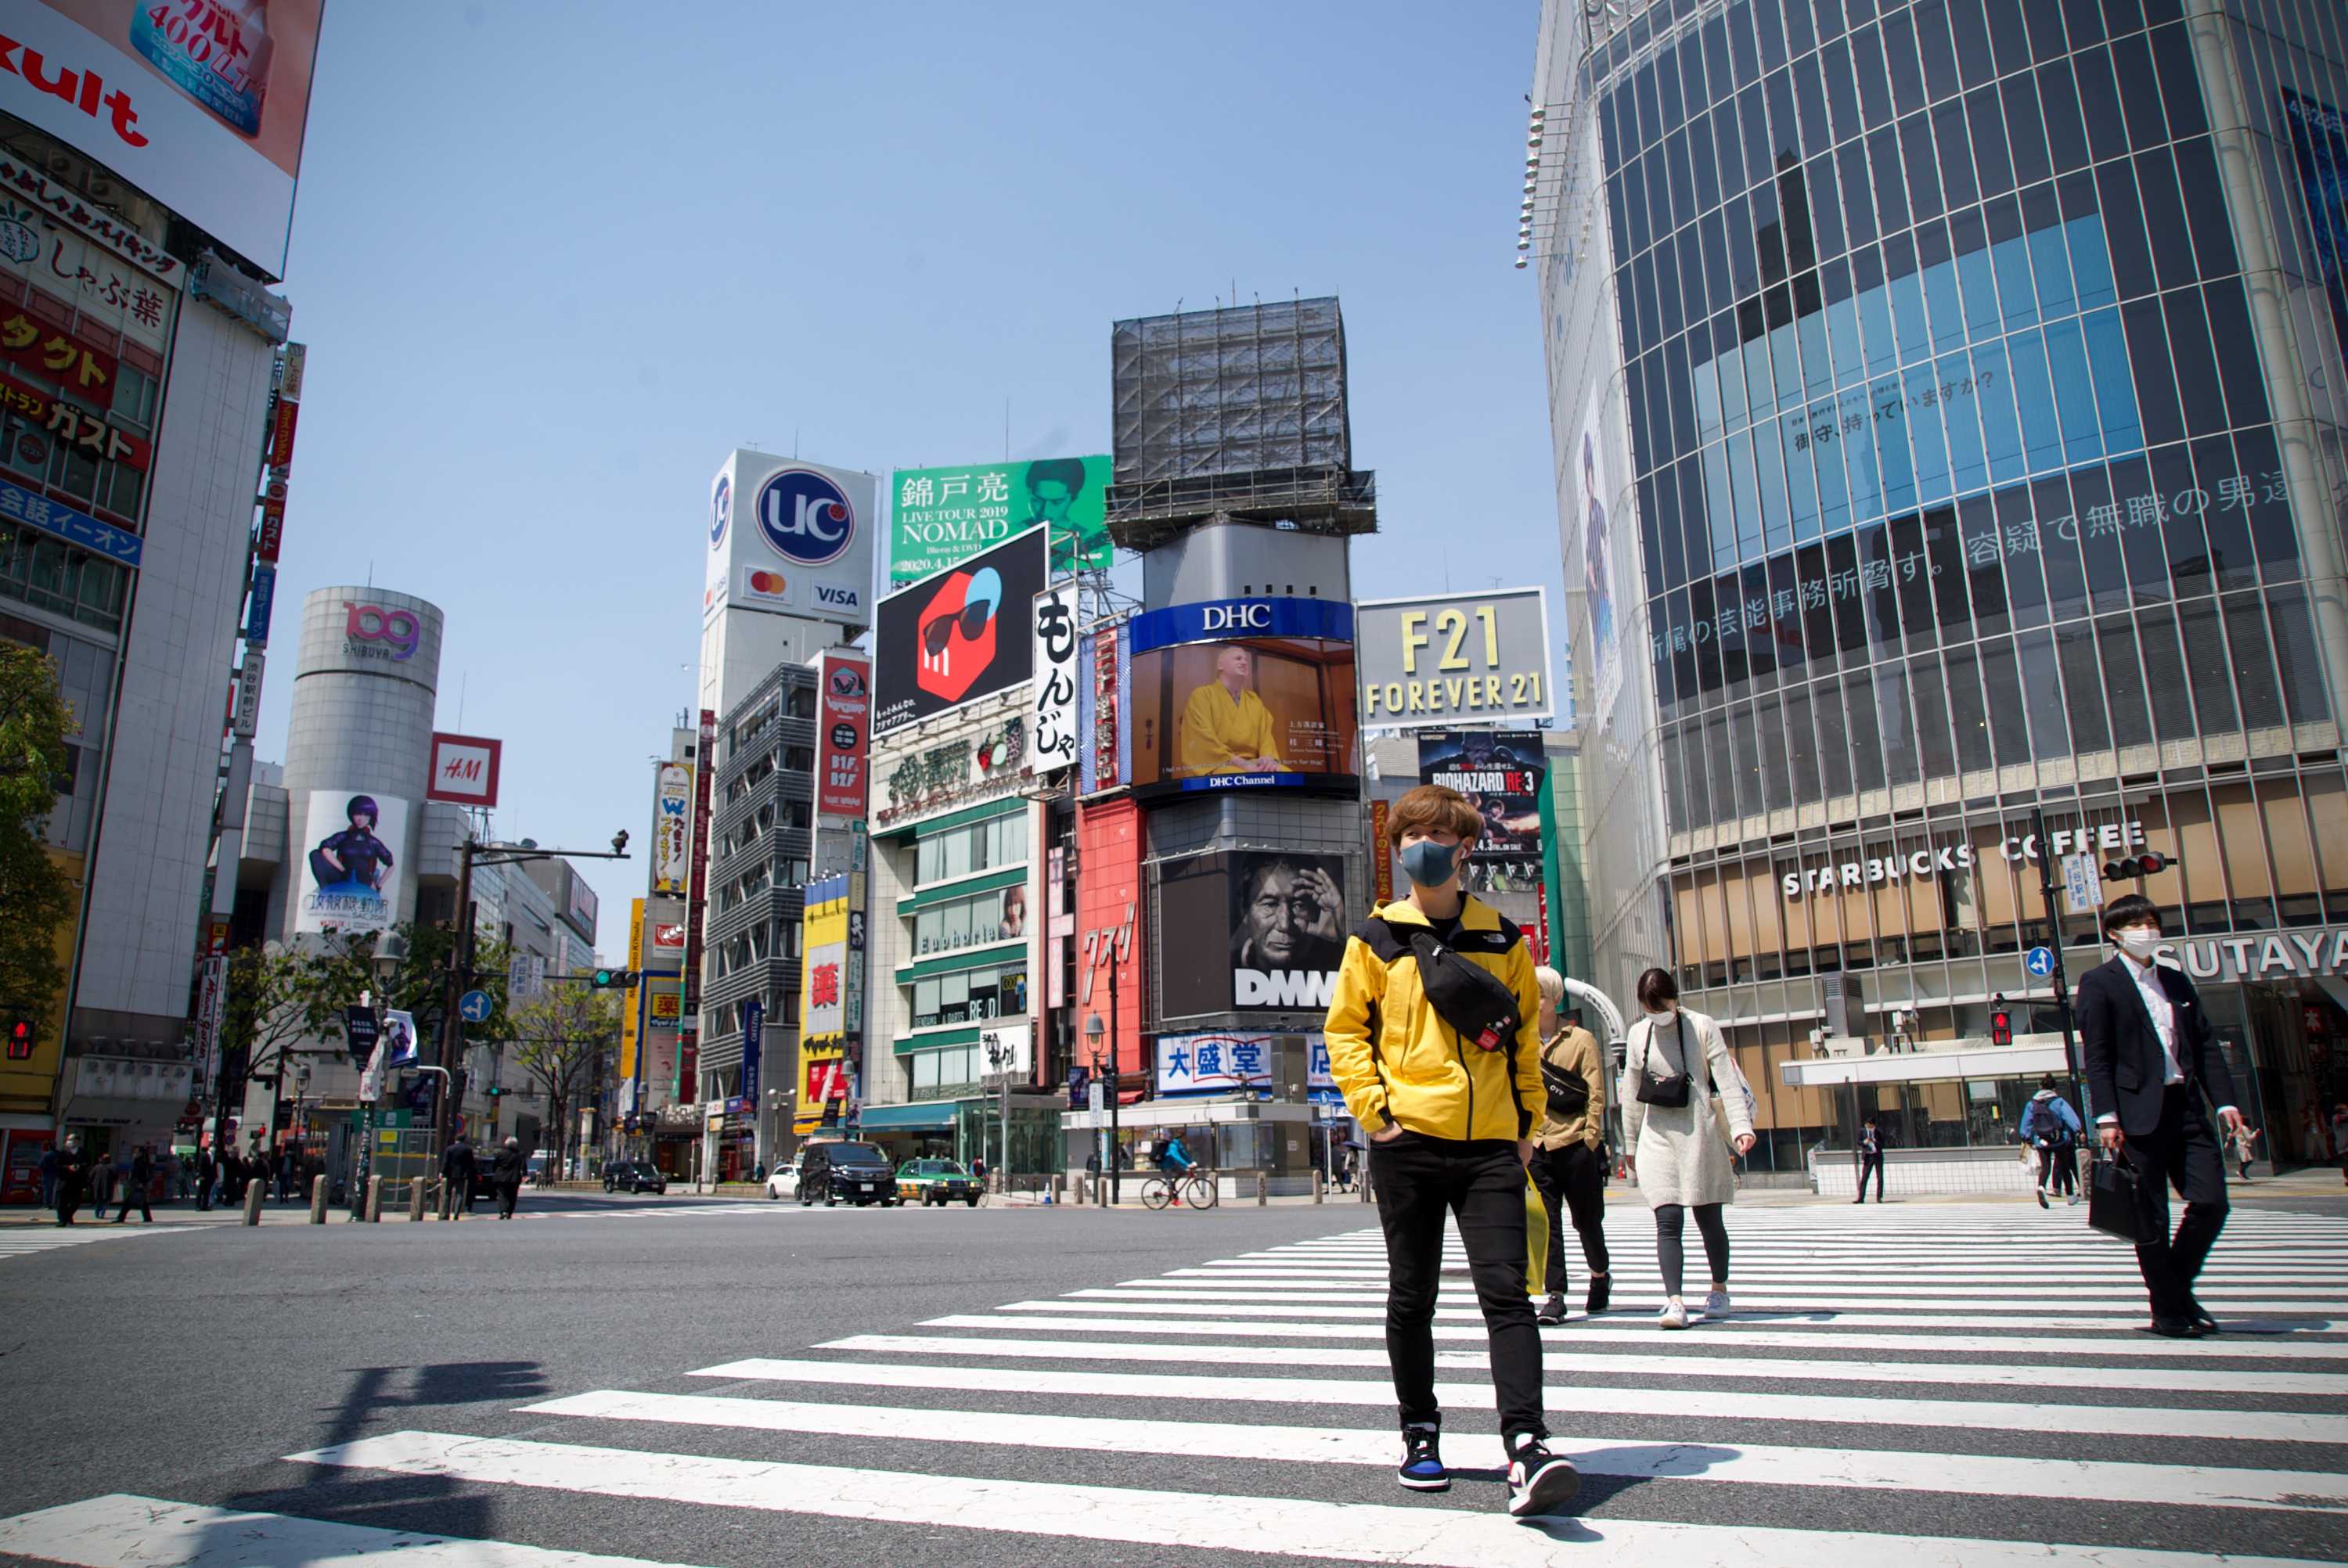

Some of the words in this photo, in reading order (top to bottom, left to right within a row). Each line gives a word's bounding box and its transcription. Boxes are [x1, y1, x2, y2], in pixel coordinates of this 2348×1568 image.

[51, 238, 164, 329] しゃぶ葉
[46, 400, 133, 461] ガスト
[901, 472, 1010, 509] 錦戸亮
[768, 487, 847, 542] UC
[902, 509, 934, 524] LIVE
[938, 508, 976, 522] TOUR
[979, 505, 1009, 520] 2019
[902, 518, 1010, 545] NOMAD
[962, 543, 982, 553] DVD
[815, 585, 859, 607] VISA
[343, 601, 420, 661] 109
[1202, 603, 1271, 631] DHC
[342, 642, 390, 660] SHIBUYA
[1401, 605, 1499, 674] F21
[1037, 592, 1075, 761] もんじゃ
[1366, 674, 1504, 715] FOREVER
[1510, 671, 1542, 705] 21
[238, 661, 260, 730] 渋谷駅前ビル
[444, 757, 482, 782] H&M
[830, 754, 857, 771] B1F
[830, 771, 857, 788] B2F
[1209, 776, 1233, 787] DHC
[1234, 775, 1276, 786] Channel
[1431, 771, 1504, 793] BIOHAZARD
[1782, 843, 1977, 897] STARBUCKS
[1999, 820, 2145, 861] COFFEE
[1082, 901, 1136, 1005] クスリ
[1234, 967, 1340, 1007] DMM
[751, 1009, 760, 1042] MIZUNO
[1167, 1043, 1262, 1079] 大盛堂
